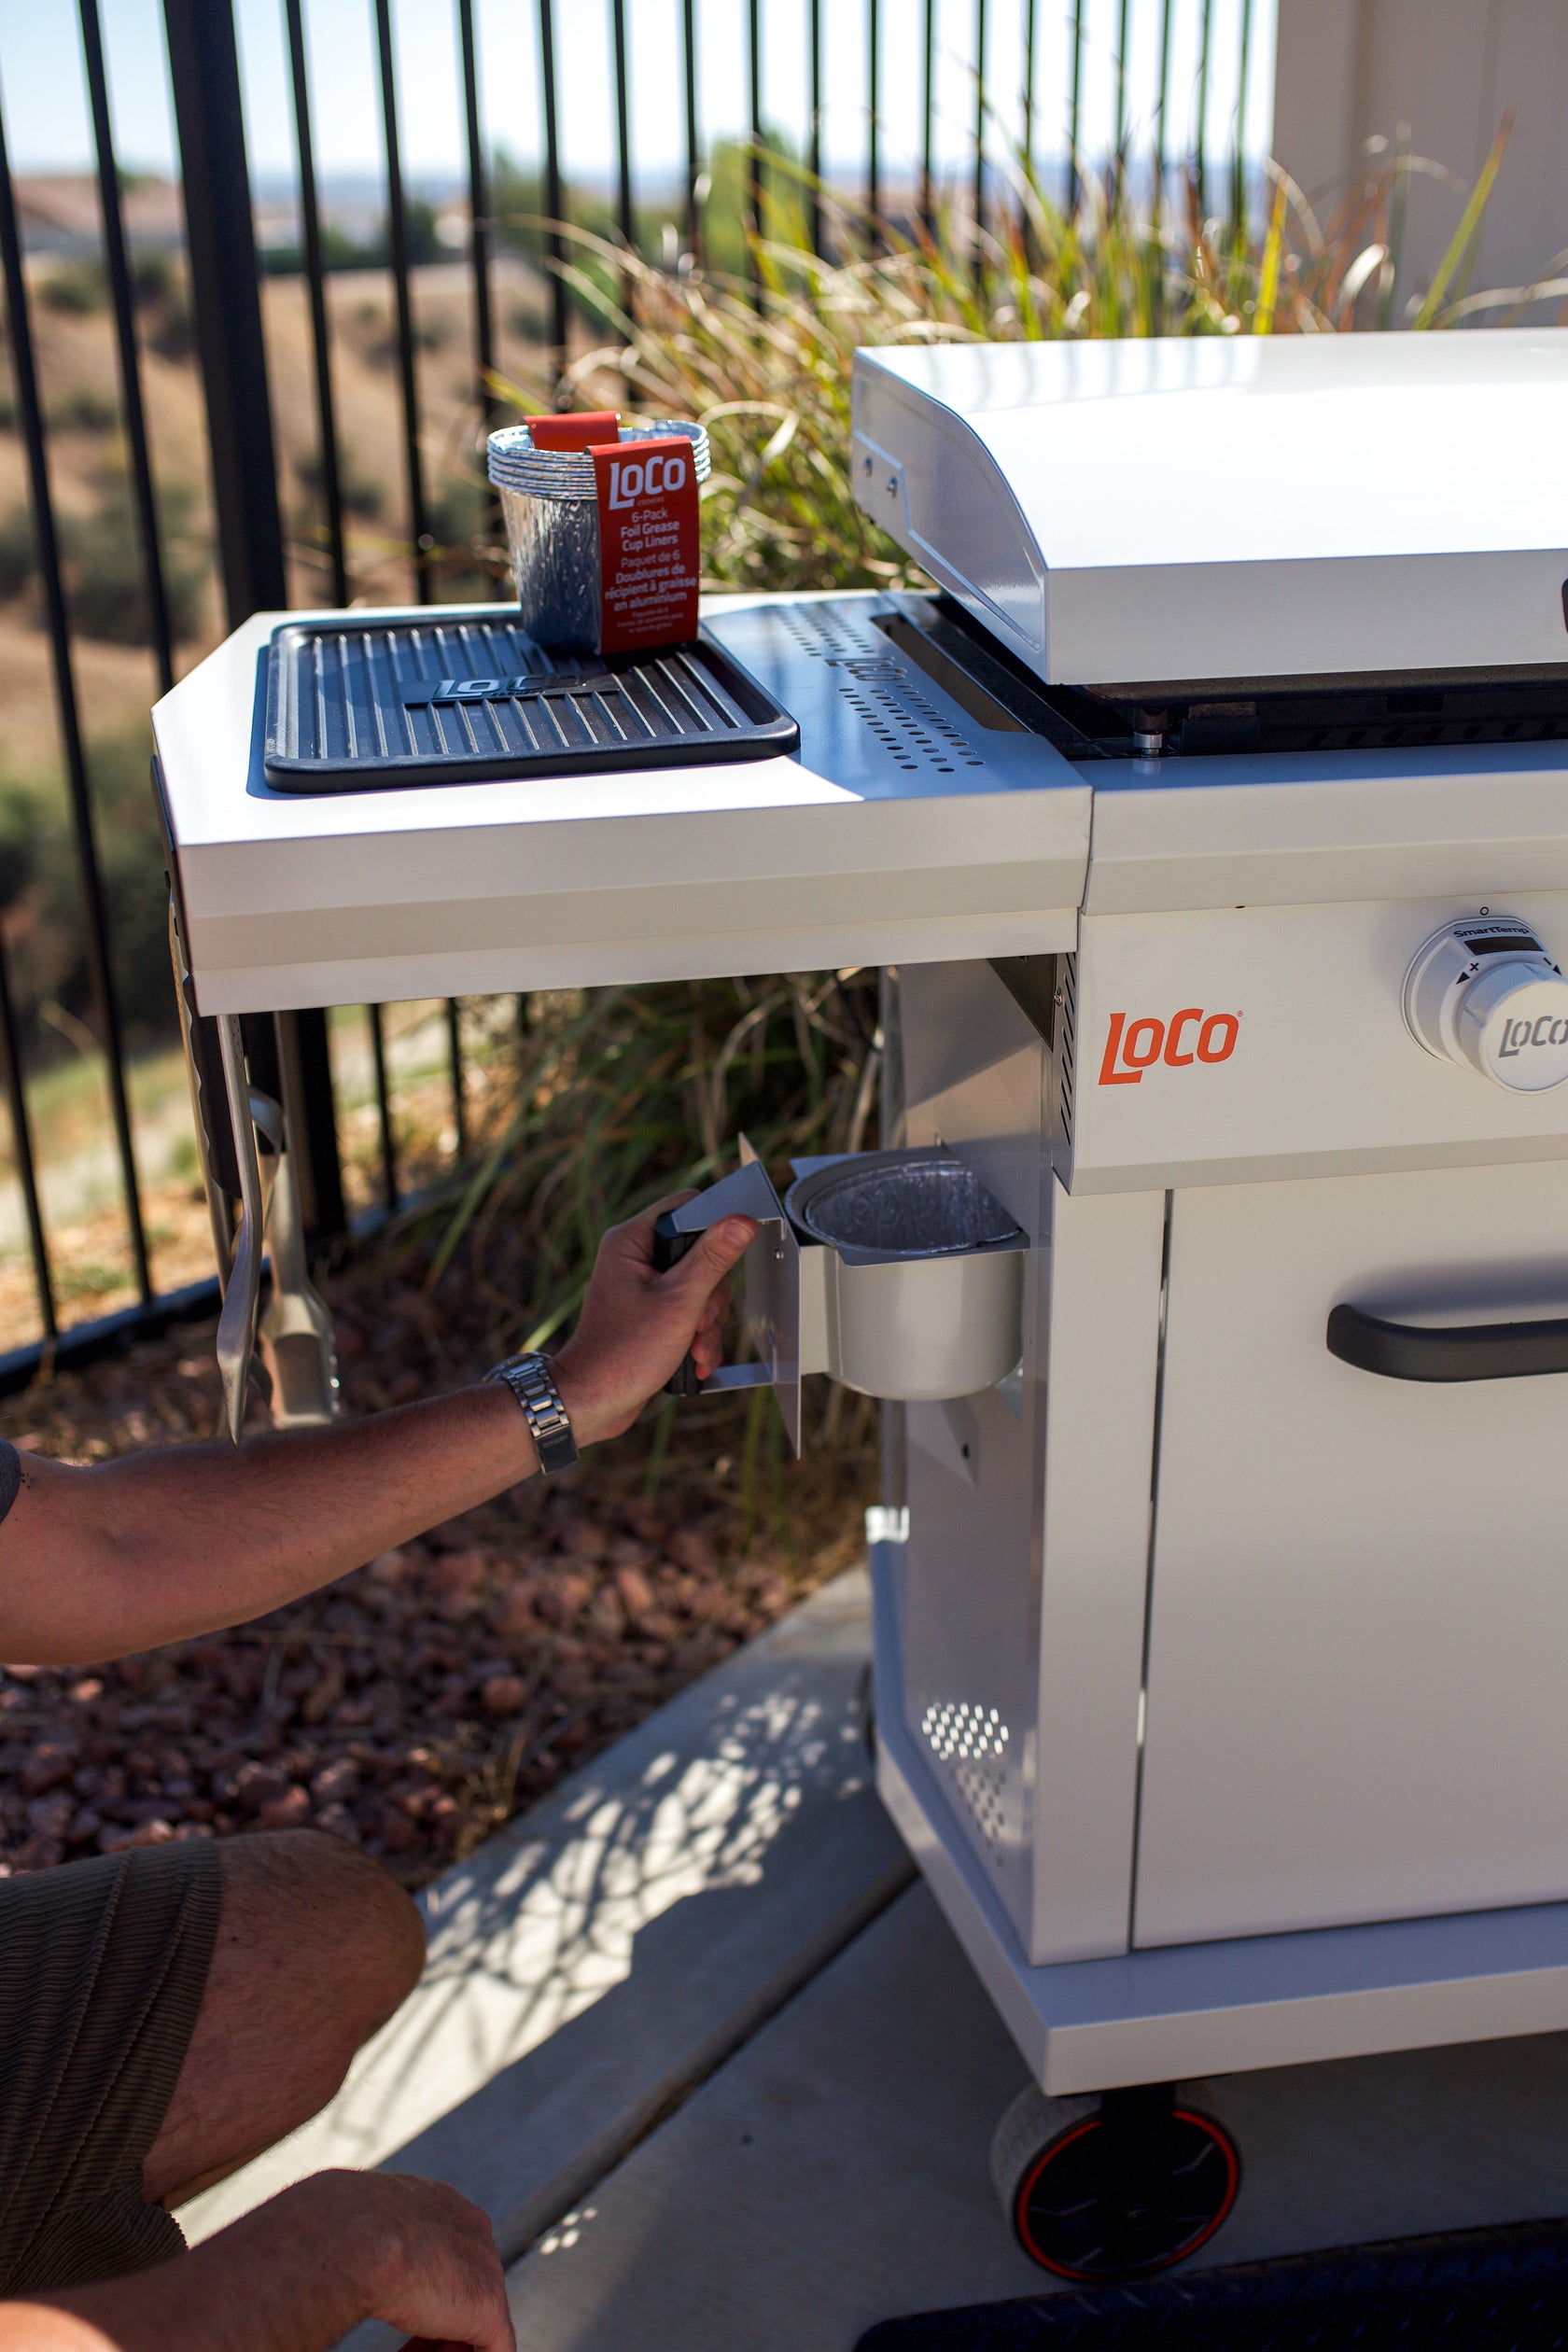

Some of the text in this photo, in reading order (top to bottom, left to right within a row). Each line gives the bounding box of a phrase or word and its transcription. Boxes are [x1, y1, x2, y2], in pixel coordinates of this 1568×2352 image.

[631, 507, 668, 523] 6-Pack
[620, 521, 680, 539] Foil Grease
[622, 535, 679, 553] Cup Liners
[621, 549, 680, 568] Paquet de 6
[616, 563, 686, 584] Doublures de
[605, 576, 697, 600] récipient à graisse
[613, 592, 688, 612] en aluminium
[1454, 926, 1531, 938] SmartTemp
